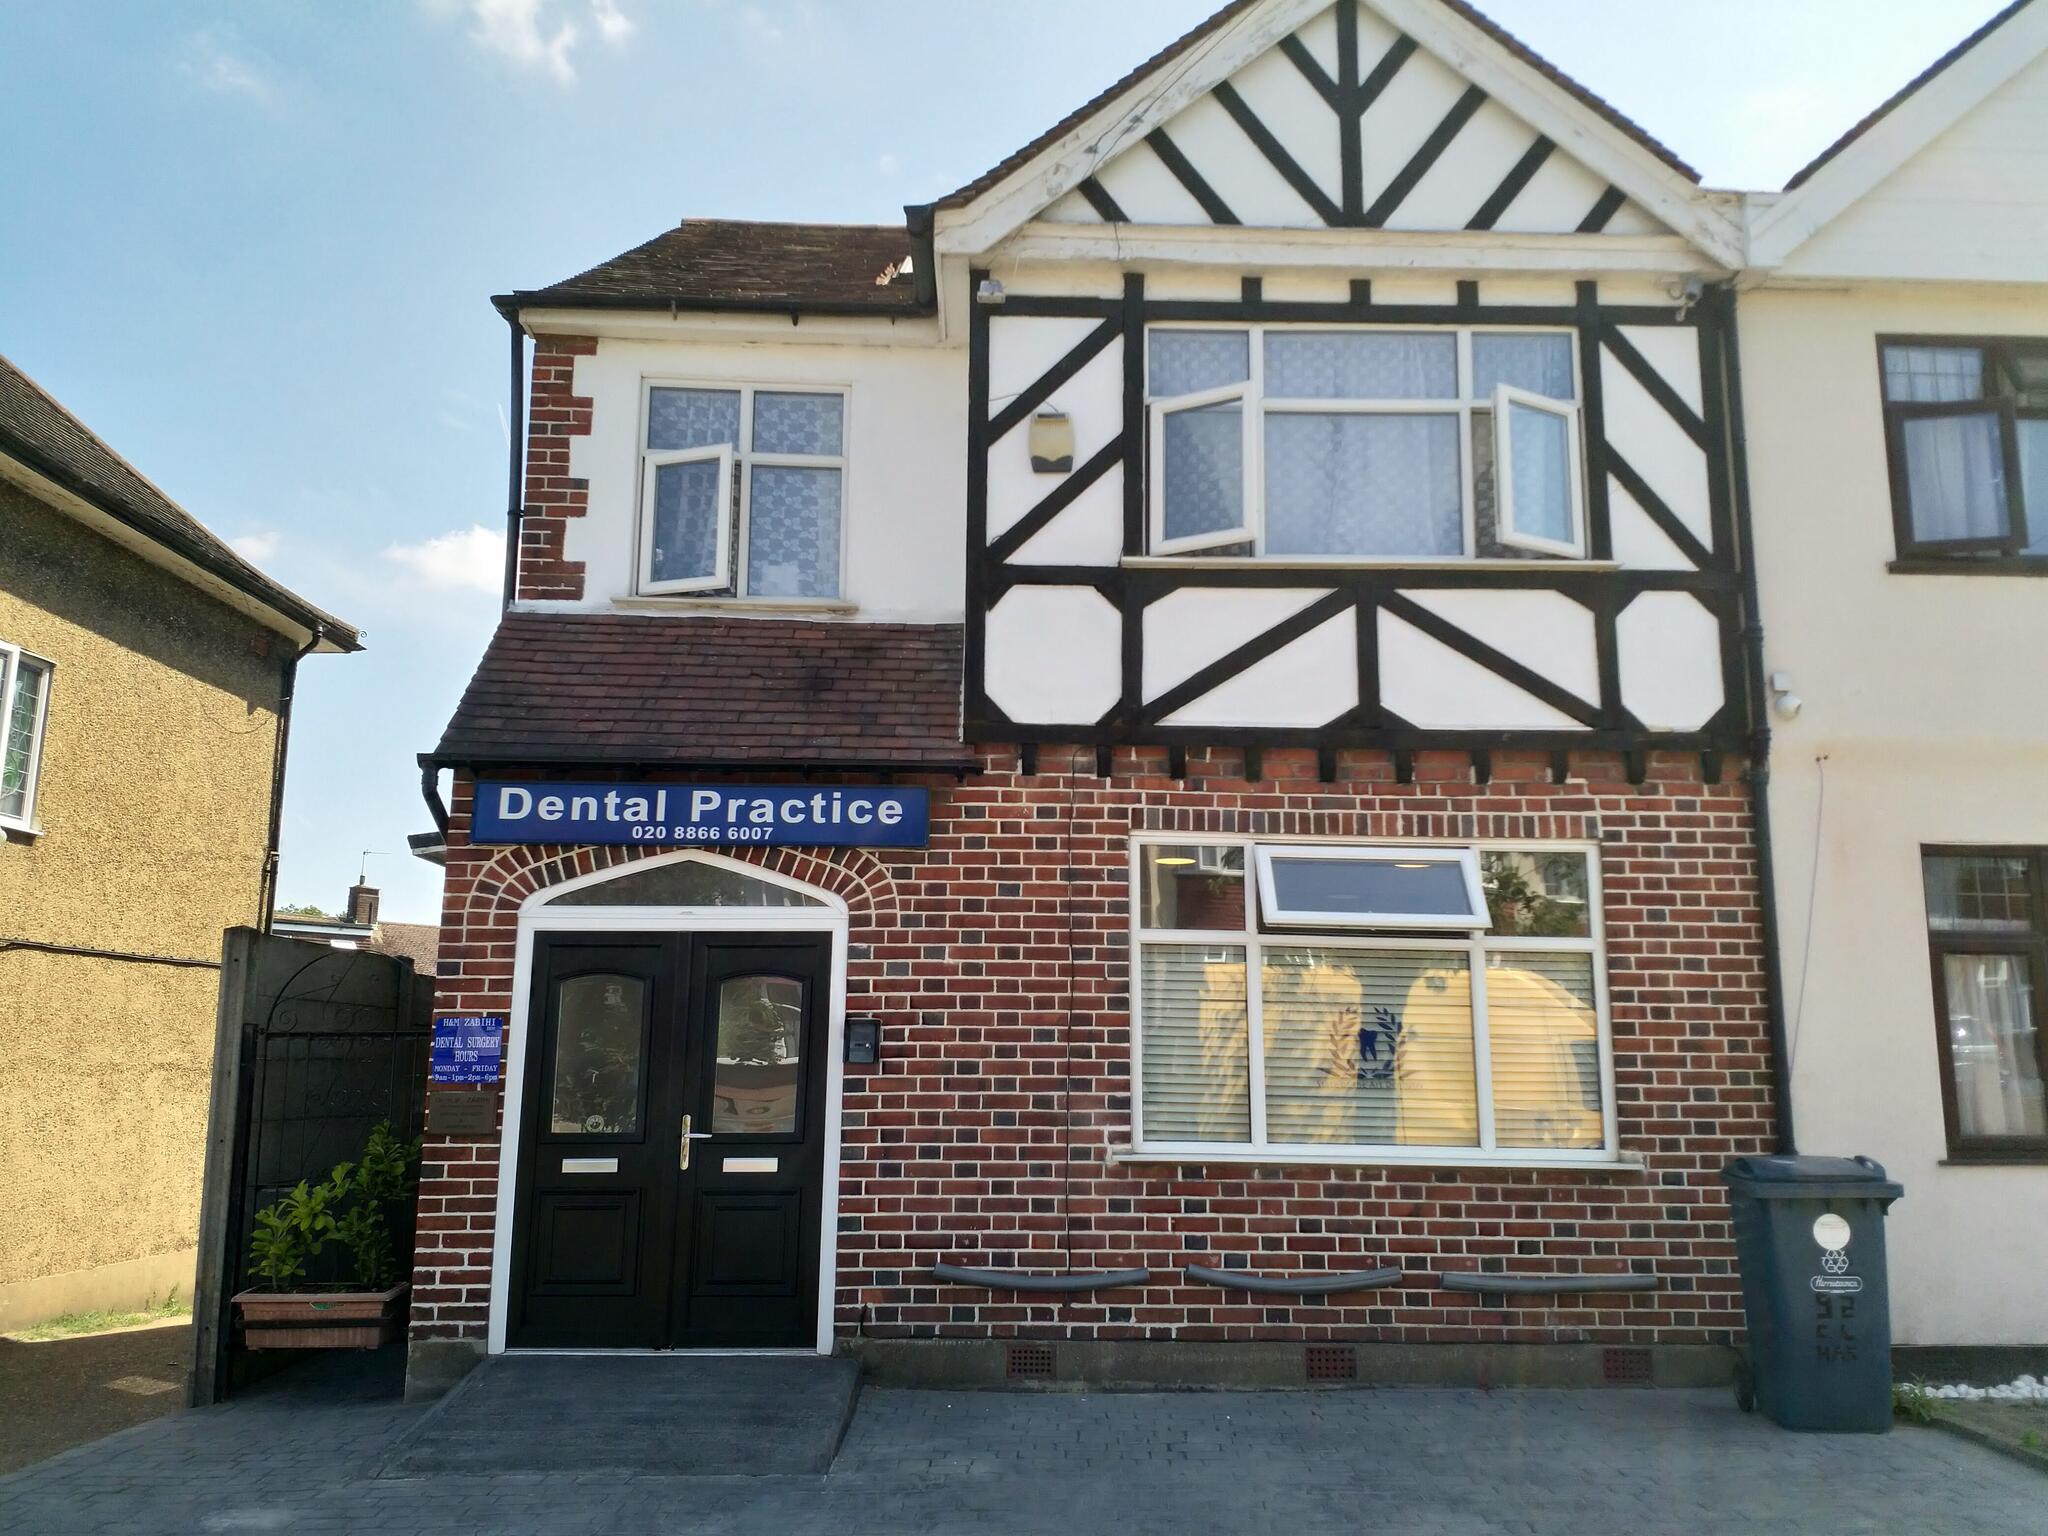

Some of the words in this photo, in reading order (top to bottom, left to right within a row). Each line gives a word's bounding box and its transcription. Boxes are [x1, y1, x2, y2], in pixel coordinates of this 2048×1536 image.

[498, 787, 666, 822] Dental
[690, 790, 904, 825] Practice
[632, 825, 667, 840] 020
[674, 826, 720, 841] 8866
[727, 826, 774, 841] 6007
[443, 1018, 460, 1027] H&M
[464, 1018, 496, 1027] ZABIHI
[435, 1036, 463, 1049] DENTAL
[467, 1036, 500, 1049] SURGERY
[454, 1050, 479, 1062] HOURS
